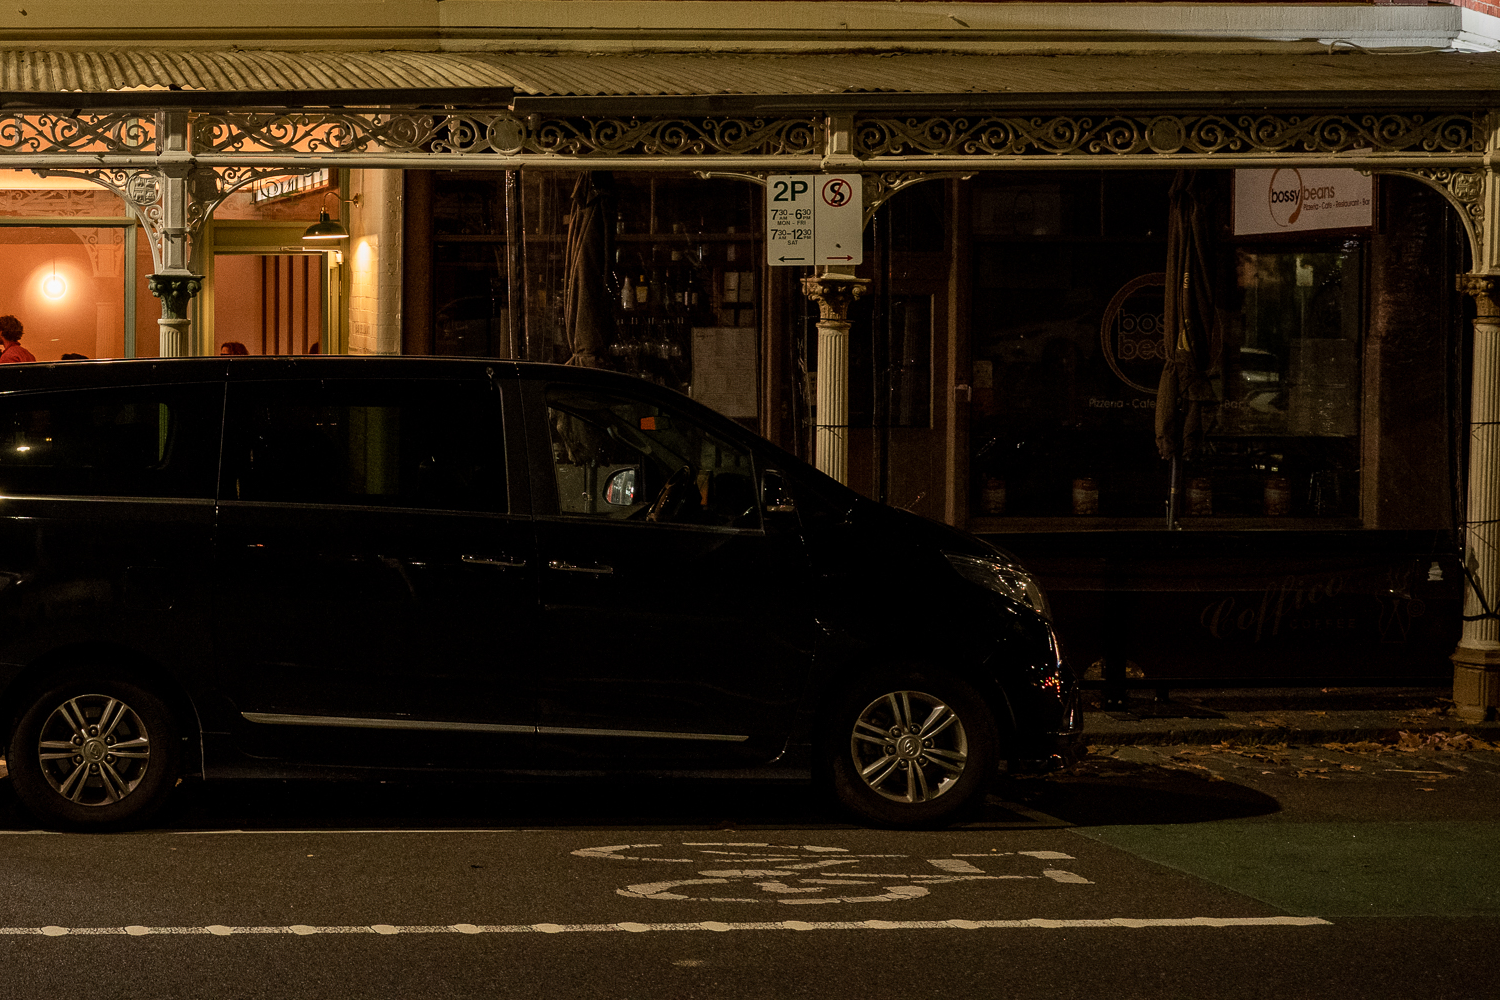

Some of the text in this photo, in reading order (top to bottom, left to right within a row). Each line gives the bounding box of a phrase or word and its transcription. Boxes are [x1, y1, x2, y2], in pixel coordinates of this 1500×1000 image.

[773, 180, 808, 202] 2P
[1271, 186, 1335, 205] bossy beans
[1289, 618, 1357, 630] COFFEE
